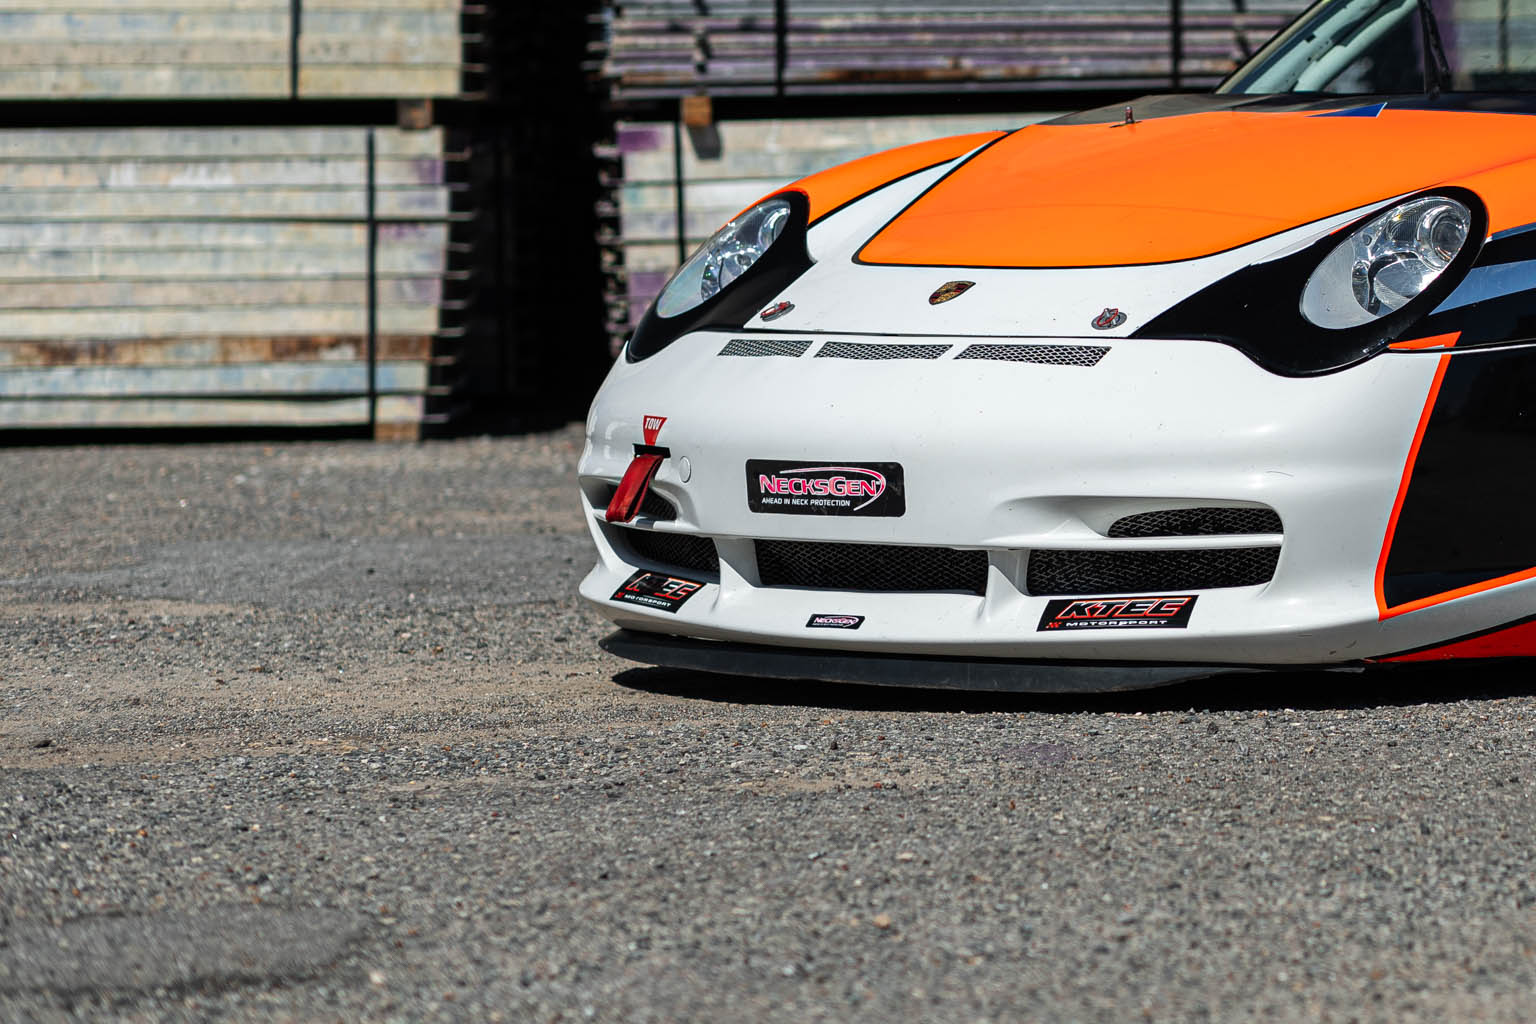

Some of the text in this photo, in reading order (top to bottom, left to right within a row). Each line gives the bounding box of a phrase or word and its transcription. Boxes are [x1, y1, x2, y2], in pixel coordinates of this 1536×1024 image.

[644, 417, 664, 431] TOW
[761, 497, 783, 505] AHEAD
[809, 499, 851, 507] PROTECTION
[1055, 597, 1193, 620] KTEC
[1065, 619, 1168, 627] MOTORSPORT
